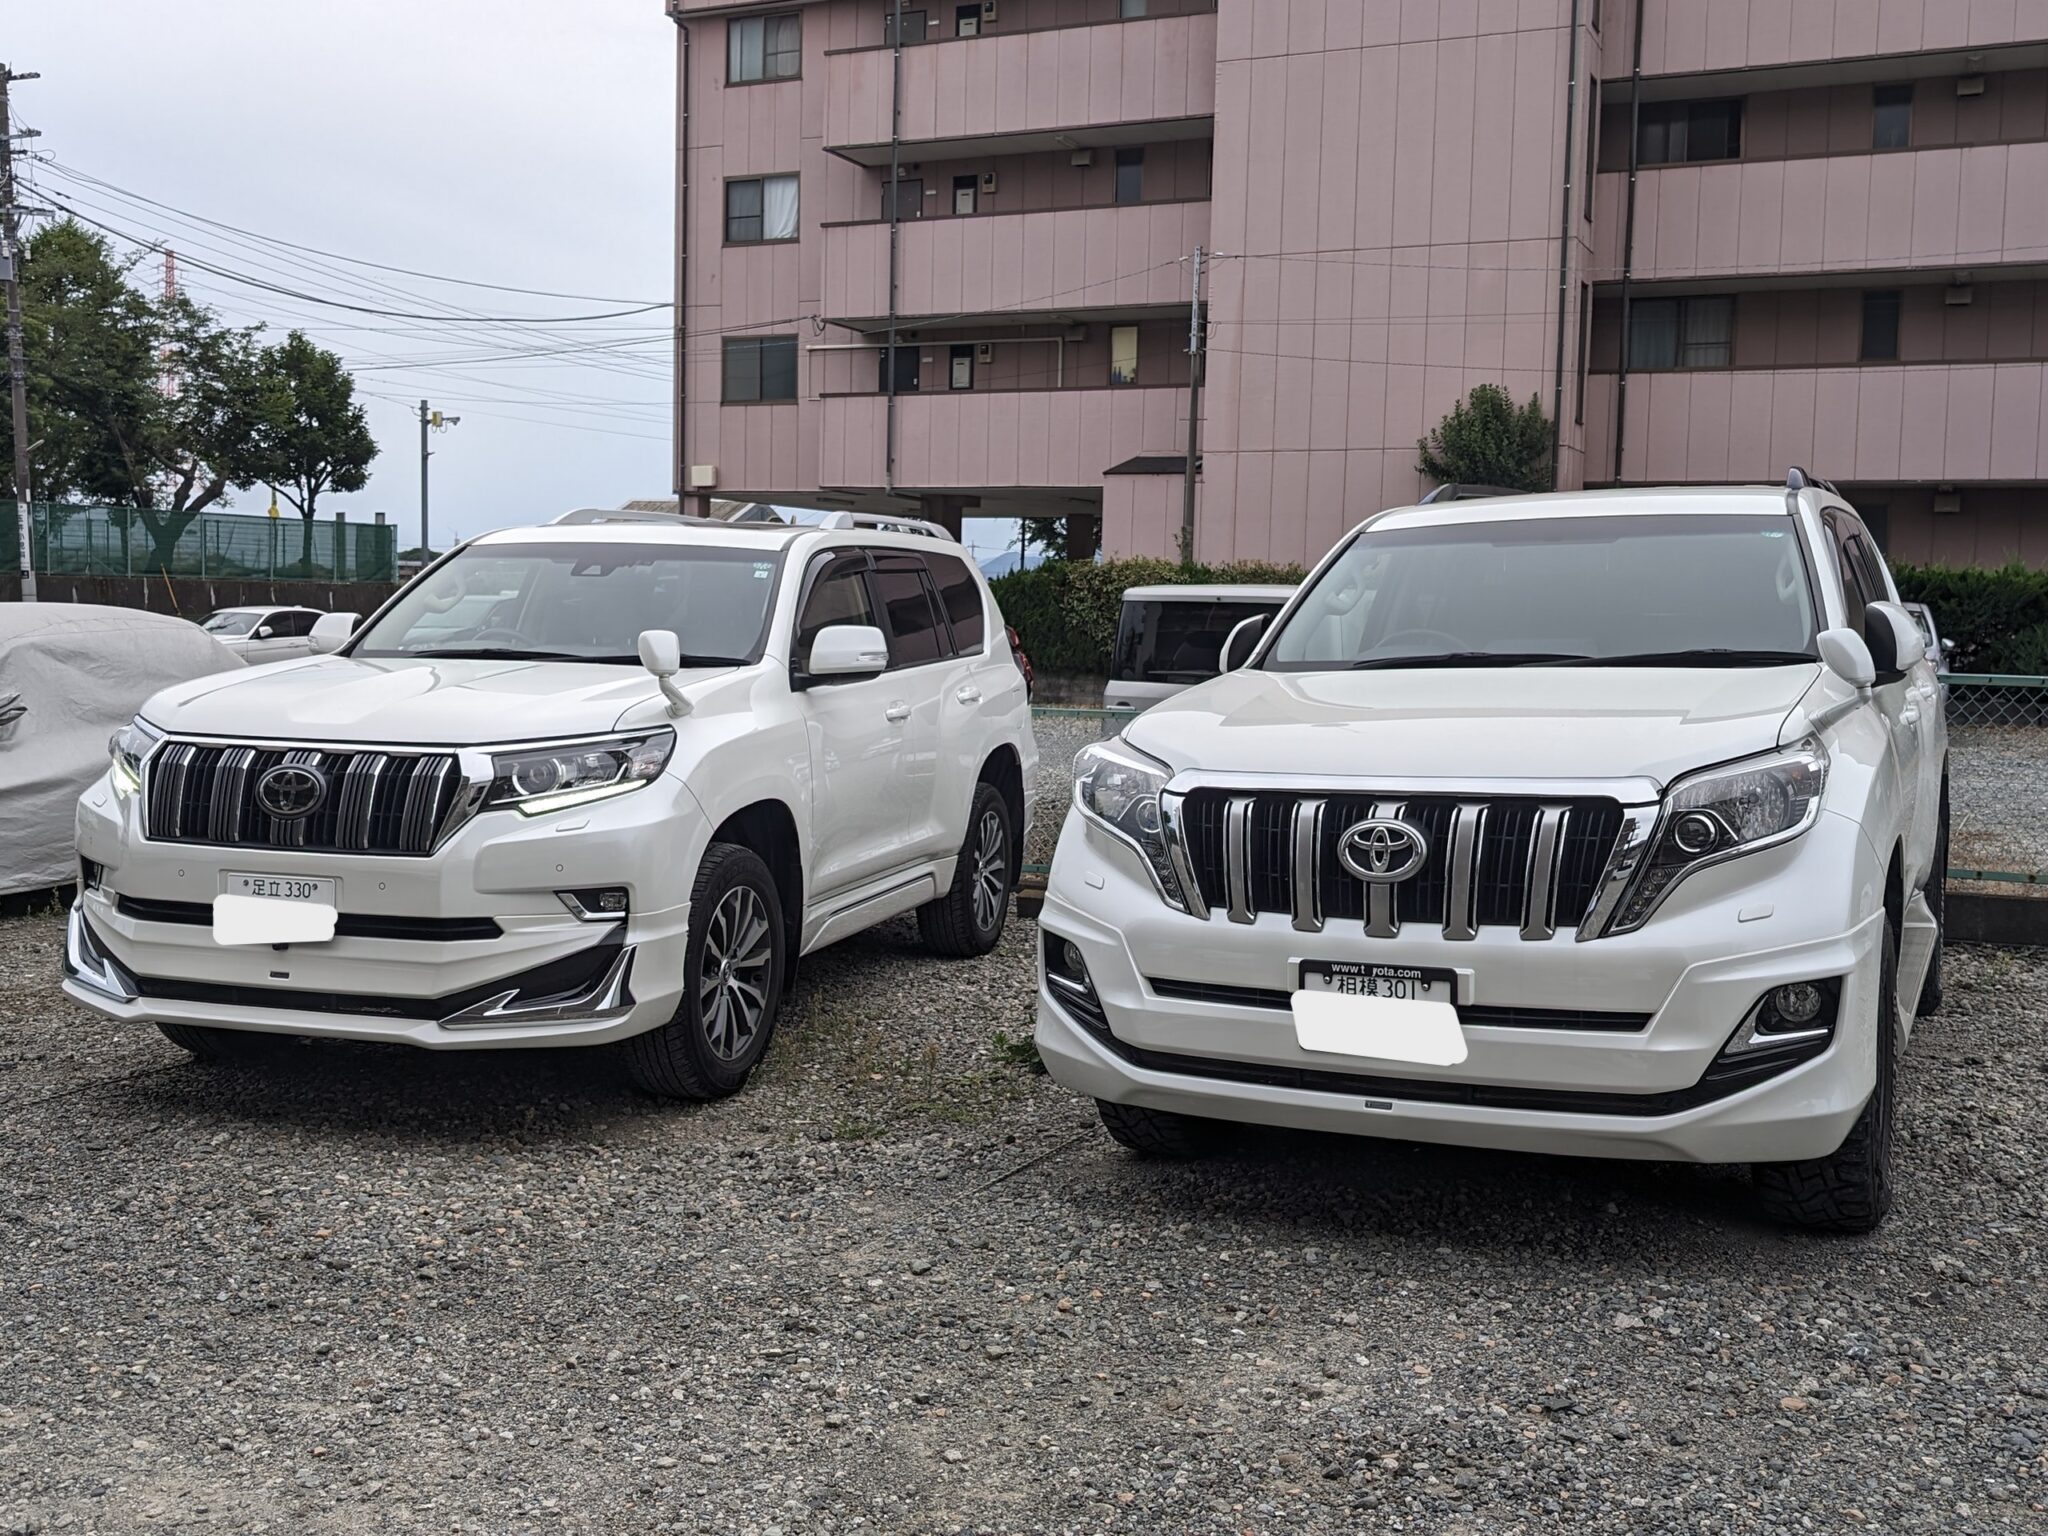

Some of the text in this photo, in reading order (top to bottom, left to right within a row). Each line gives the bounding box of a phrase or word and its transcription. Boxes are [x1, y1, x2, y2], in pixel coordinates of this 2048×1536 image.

[252, 879, 311, 898] 足立 330
[1337, 975, 1415, 1000] 相模 301
